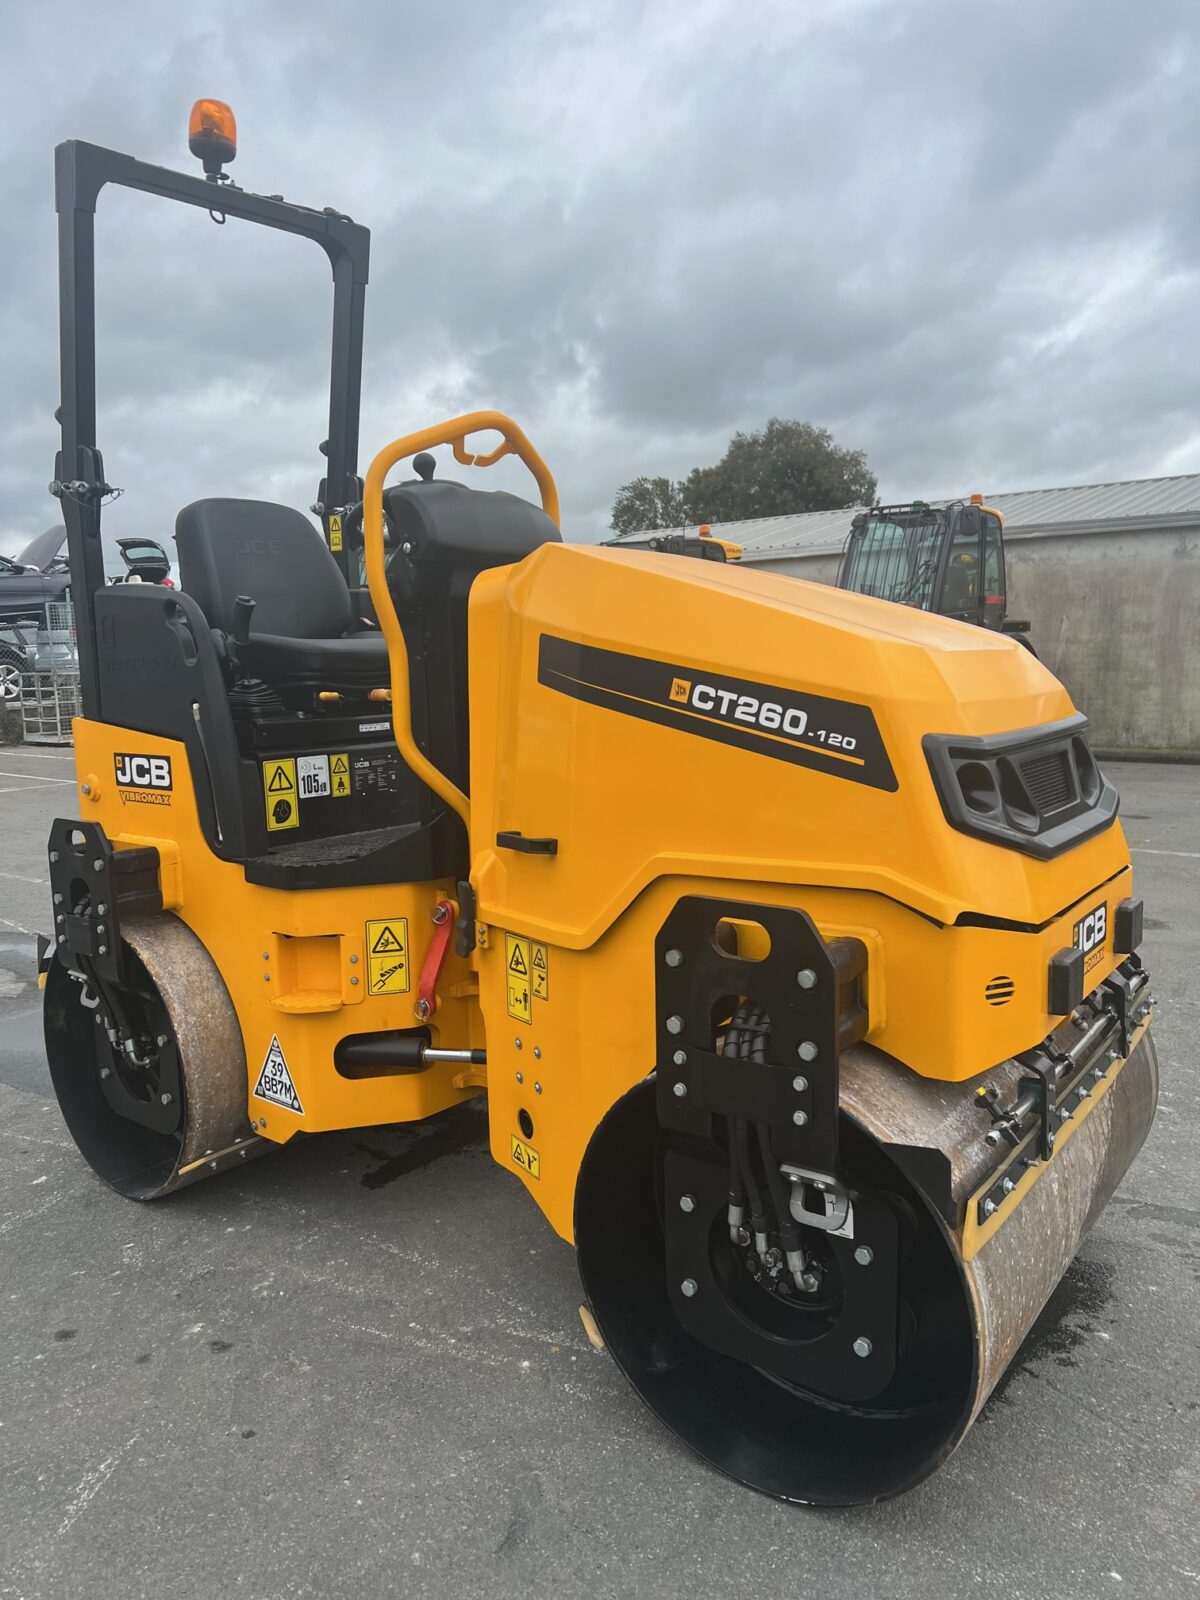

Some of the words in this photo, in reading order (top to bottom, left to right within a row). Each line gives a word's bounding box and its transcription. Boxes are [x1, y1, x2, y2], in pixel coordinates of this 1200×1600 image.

[116, 756, 171, 787] JCB
[301, 774, 320, 794] 105
[118, 790, 171, 806] VIBROMAX
[1073, 906, 1106, 952] JCB
[1084, 947, 1105, 975] ROMAX
[270, 1060, 283, 1078] 39
